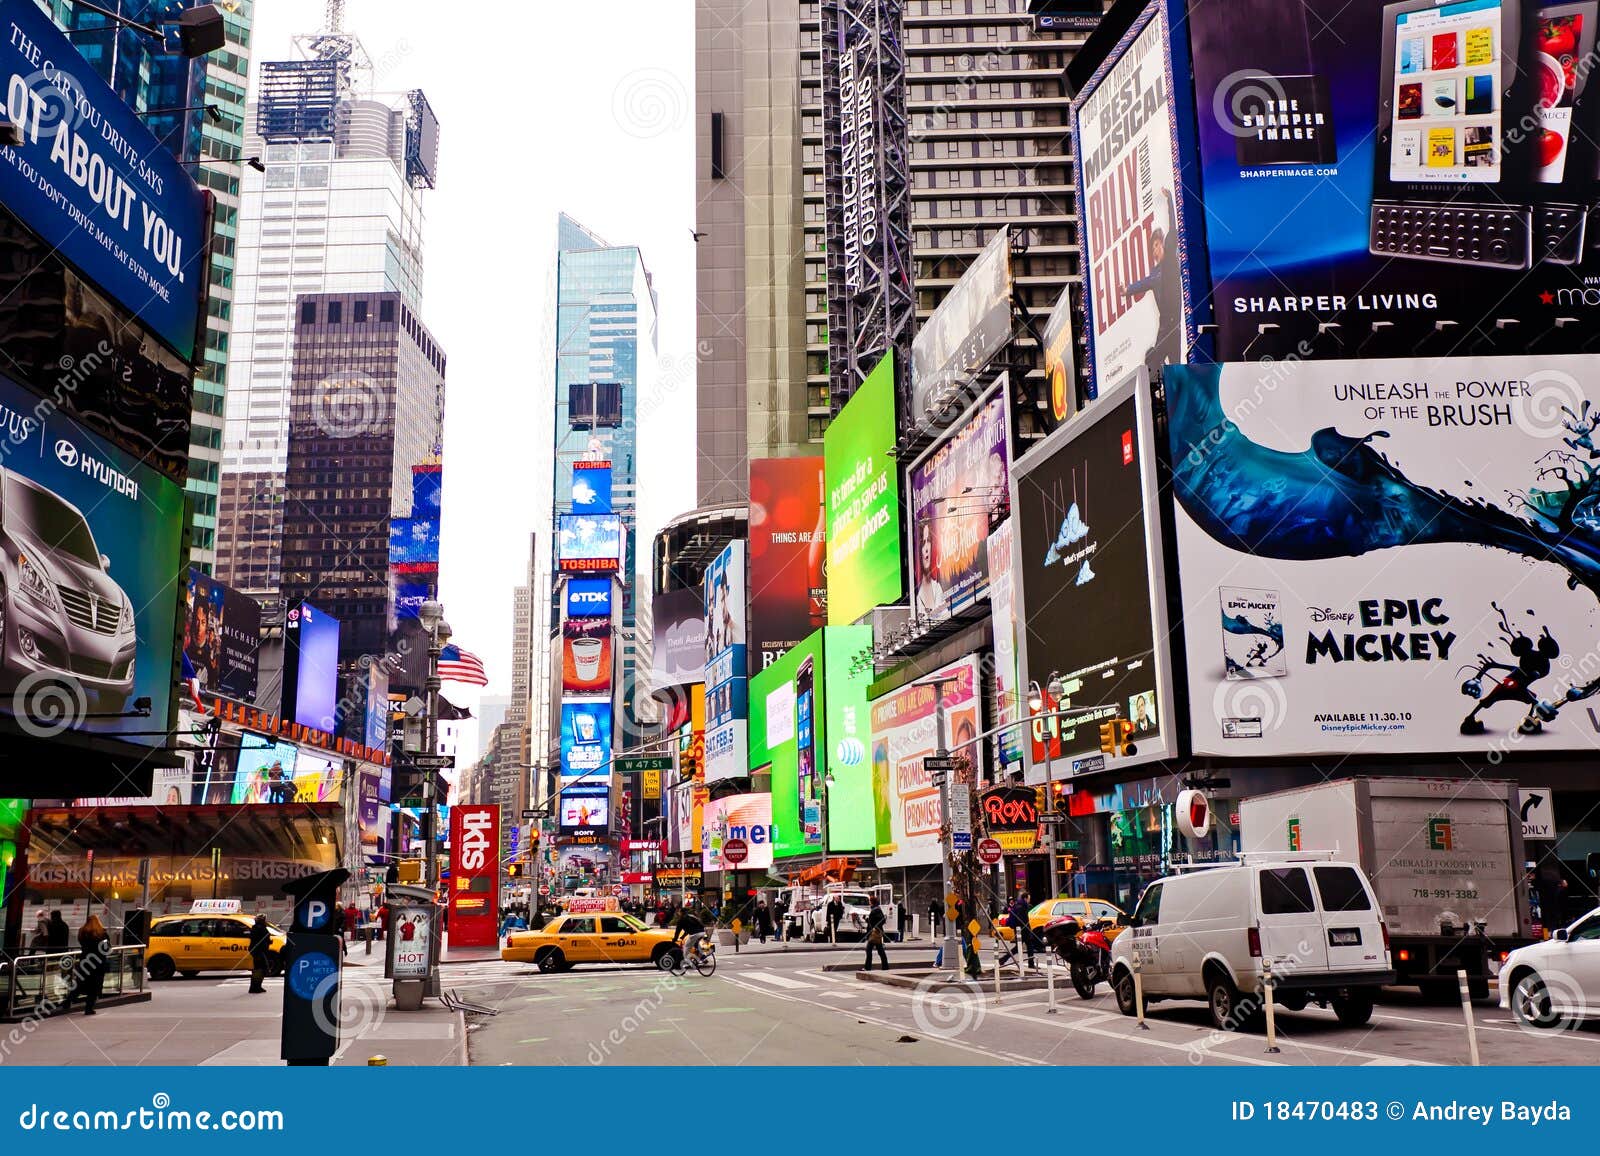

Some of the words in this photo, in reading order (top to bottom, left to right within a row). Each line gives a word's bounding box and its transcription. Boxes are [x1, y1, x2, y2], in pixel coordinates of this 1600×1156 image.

[1134, 19, 1160, 65] WINNER
[840, 52, 858, 138] EAGLE
[1100, 64, 1142, 139] BEST
[1267, 100, 1299, 112] THE
[10, 22, 41, 69] THE
[42, 59, 71, 103] CAR
[73, 92, 101, 128] YOU
[101, 119, 138, 170] DRIVE
[138, 162, 164, 197] SAYS
[1243, 113, 1325, 127] SHARPER
[1541, 111, 1568, 119] AUCE
[1085, 75, 1168, 190] MUSICAL
[1257, 128, 1315, 141] IMAGE
[857, 75, 877, 246] OUTFITTERS
[0, 73, 47, 145] OT
[50, 119, 137, 232] ABOUT
[142, 201, 185, 283] YOU.
[1240, 168, 1338, 178] SHARPERIMAGE.COM
[0, 146, 15, 166] AR
[18, 158, 38, 184] YOU
[38, 175, 68, 212] DON'T
[68, 203, 96, 237] DRIVE
[96, 229, 114, 252] MAY
[114, 244, 128, 265] SAY
[128, 257, 149, 284] EVEN
[1089, 146, 1139, 265] BILLY
[843, 144, 862, 292] AMERICAN
[1094, 212, 1155, 337] ELLIOT
[1234, 294, 1347, 313] SHARPER
[1358, 293, 1438, 311] LIVING
[1051, 359, 1067, 420] Q
[1334, 382, 1429, 402] UNLEASH
[1434, 391, 1450, 399] THE
[1456, 380, 1532, 399] POWER
[1364, 406, 1387, 420] OF
[1390, 405, 1418, 420] THE
[1428, 403, 1513, 427] BRUSH
[82, 453, 138, 500] HYUNDAI
[772, 532, 797, 543] THINGS
[799, 532, 812, 542] ARE
[561, 560, 619, 570] TOSHIBA
[581, 592, 608, 602] TDK
[1228, 602, 1246, 610] EPIC
[1247, 602, 1276, 610] MICKEY
[1358, 598, 1450, 628] EPIC
[224, 625, 258, 648] MICHAEL
[1305, 629, 1457, 665] MICKEY
[1313, 713, 1367, 723] AVAILABLE
[1369, 712, 1412, 722] 11.30.10
[1321, 723, 1405, 733] DisneyEpicMickey.com
[625, 761, 633, 769] W
[635, 760, 649, 768] 47
[652, 760, 662, 768] St
[693, 730, 705, 808] Kodak
[907, 799, 941, 829] PROMISES
[985, 795, 1036, 825] ROXY
[462, 810, 492, 871] tkts
[1522, 824, 1548, 835] ONLY
[1140, 855, 1152, 863] BLUE
[1198, 851, 1211, 859] BLUE
[1389, 859, 1432, 868] EMERALD
[1434, 860, 1497, 869] FOODSERVICE
[1412, 889, 1478, 899] 718-991-3382
[307, 900, 326, 928] P
[299, 960, 310, 974] P
[398, 953, 424, 963] HOT
